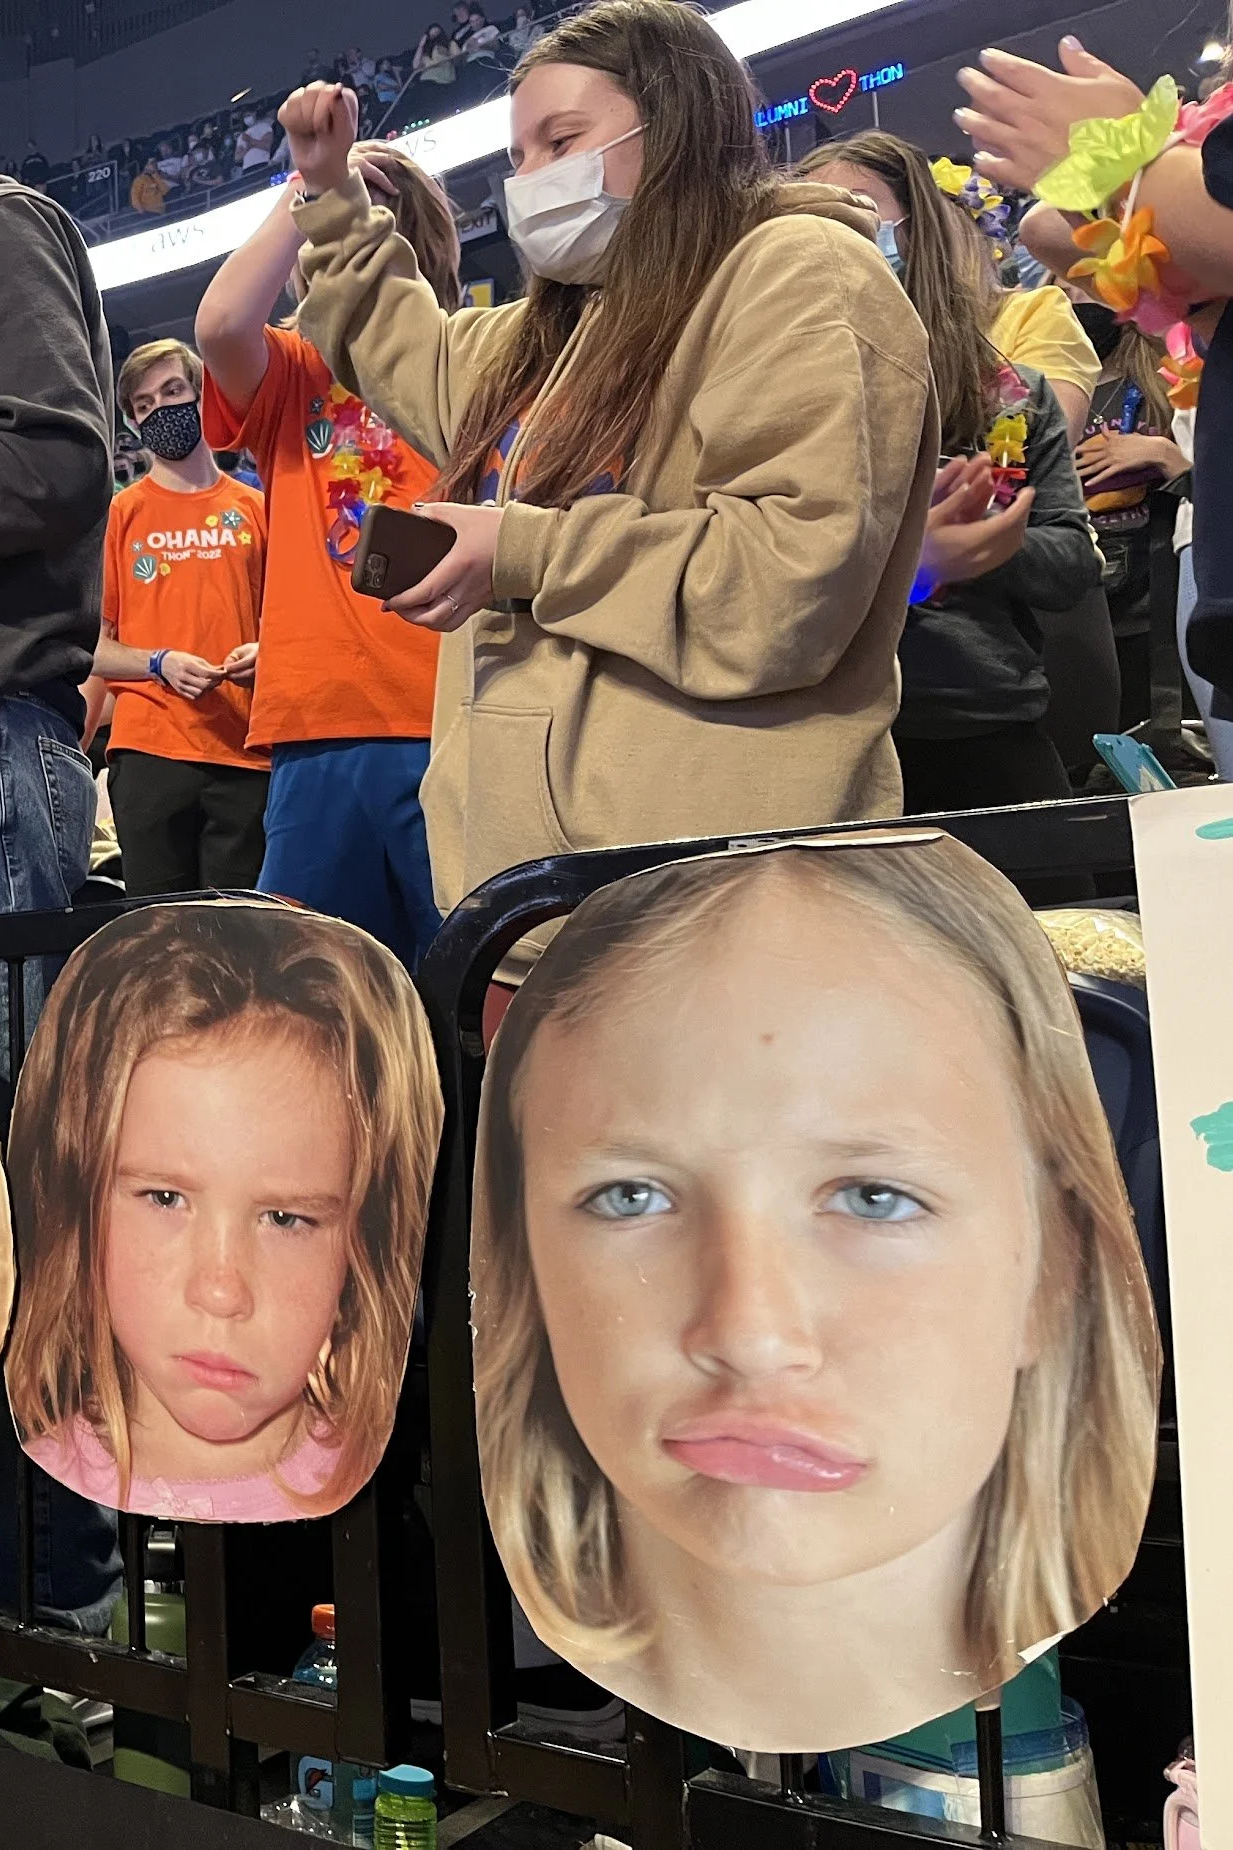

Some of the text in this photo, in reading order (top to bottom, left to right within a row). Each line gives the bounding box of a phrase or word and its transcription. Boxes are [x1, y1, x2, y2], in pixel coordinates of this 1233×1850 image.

[859, 62, 905, 92] THON
[88, 166, 112, 183] 220
[146, 528, 237, 550] OHANA
[196, 549, 223, 560] 2022
